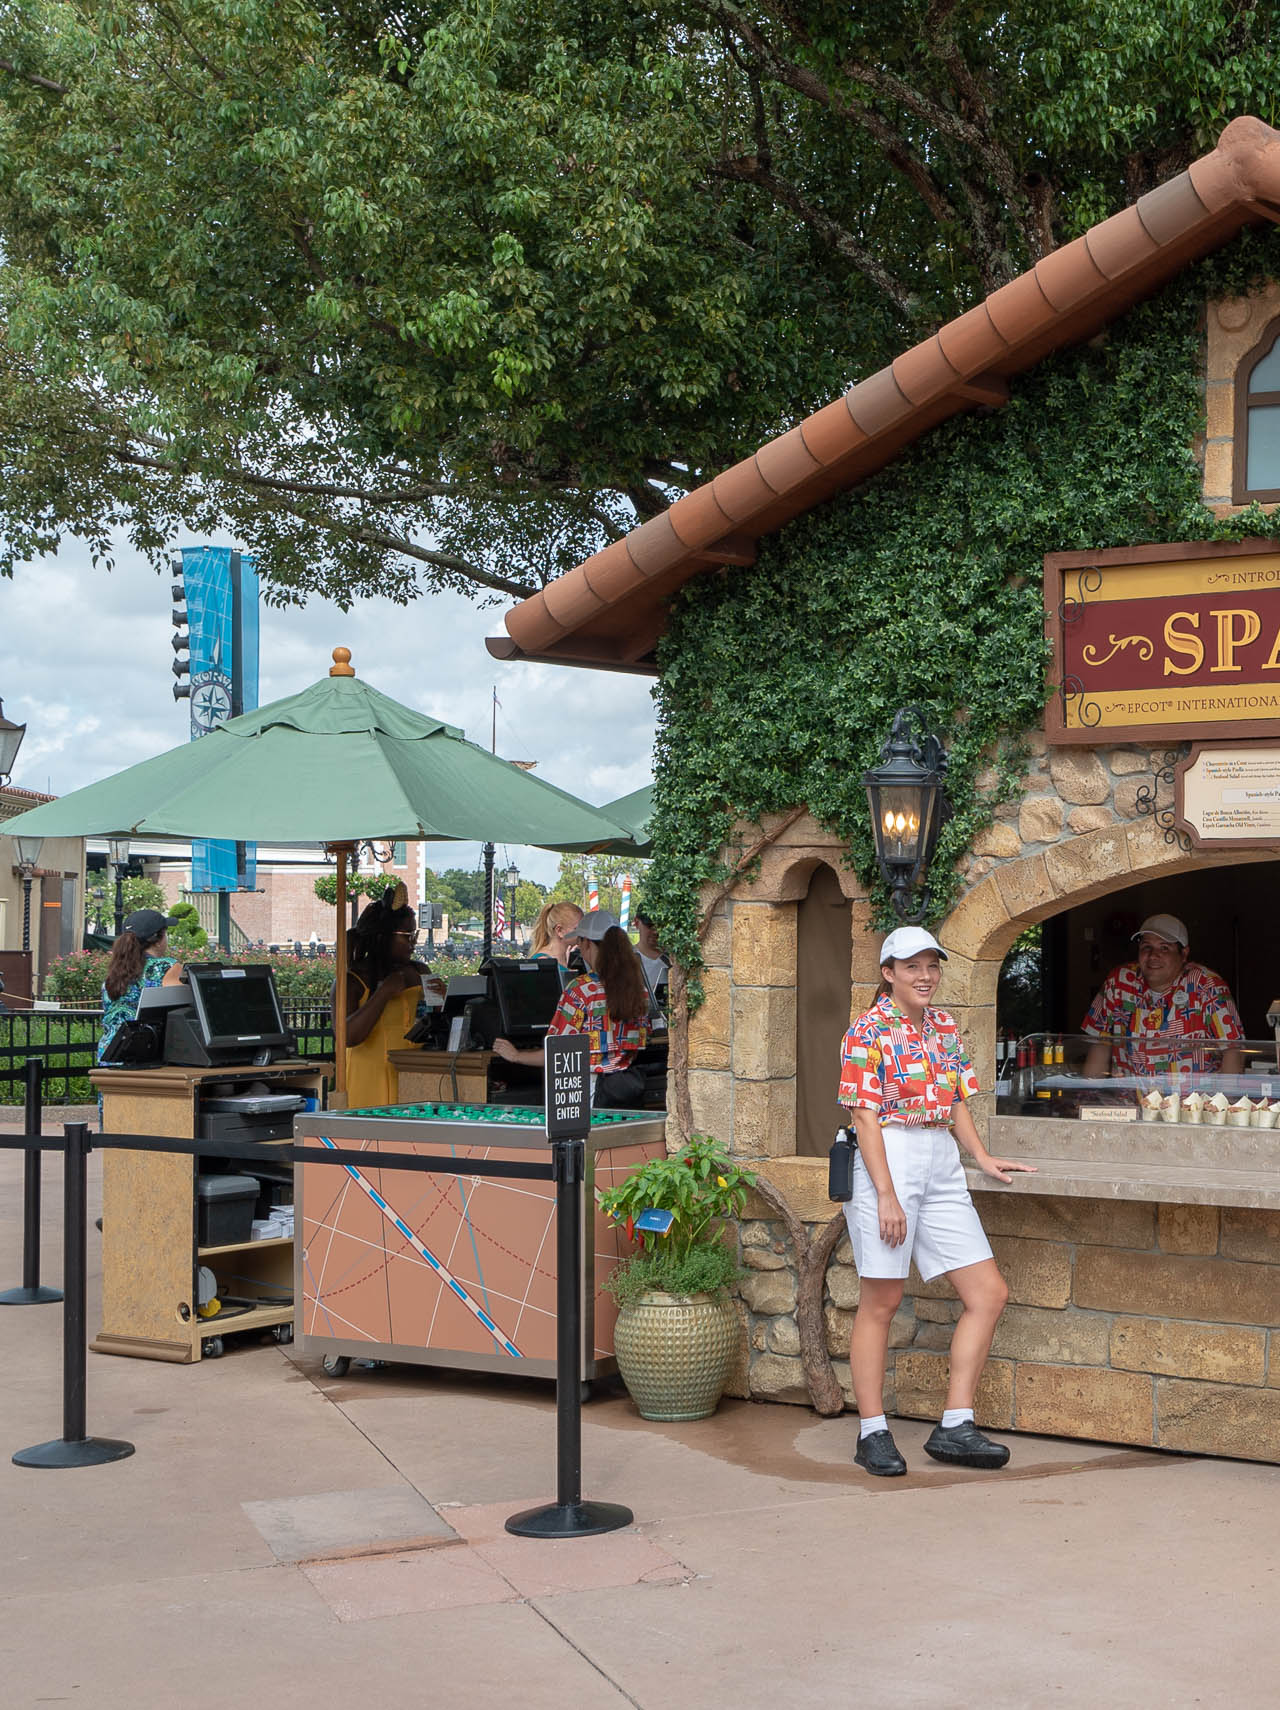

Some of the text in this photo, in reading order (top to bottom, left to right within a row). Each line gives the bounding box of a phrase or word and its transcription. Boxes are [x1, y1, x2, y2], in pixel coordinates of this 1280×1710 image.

[554, 1052, 583, 1074] EXIT
[554, 1076, 582, 1090] PLEASE
[555, 1091, 583, 1105] DO NOT
[556, 1106, 580, 1120] ENTER
